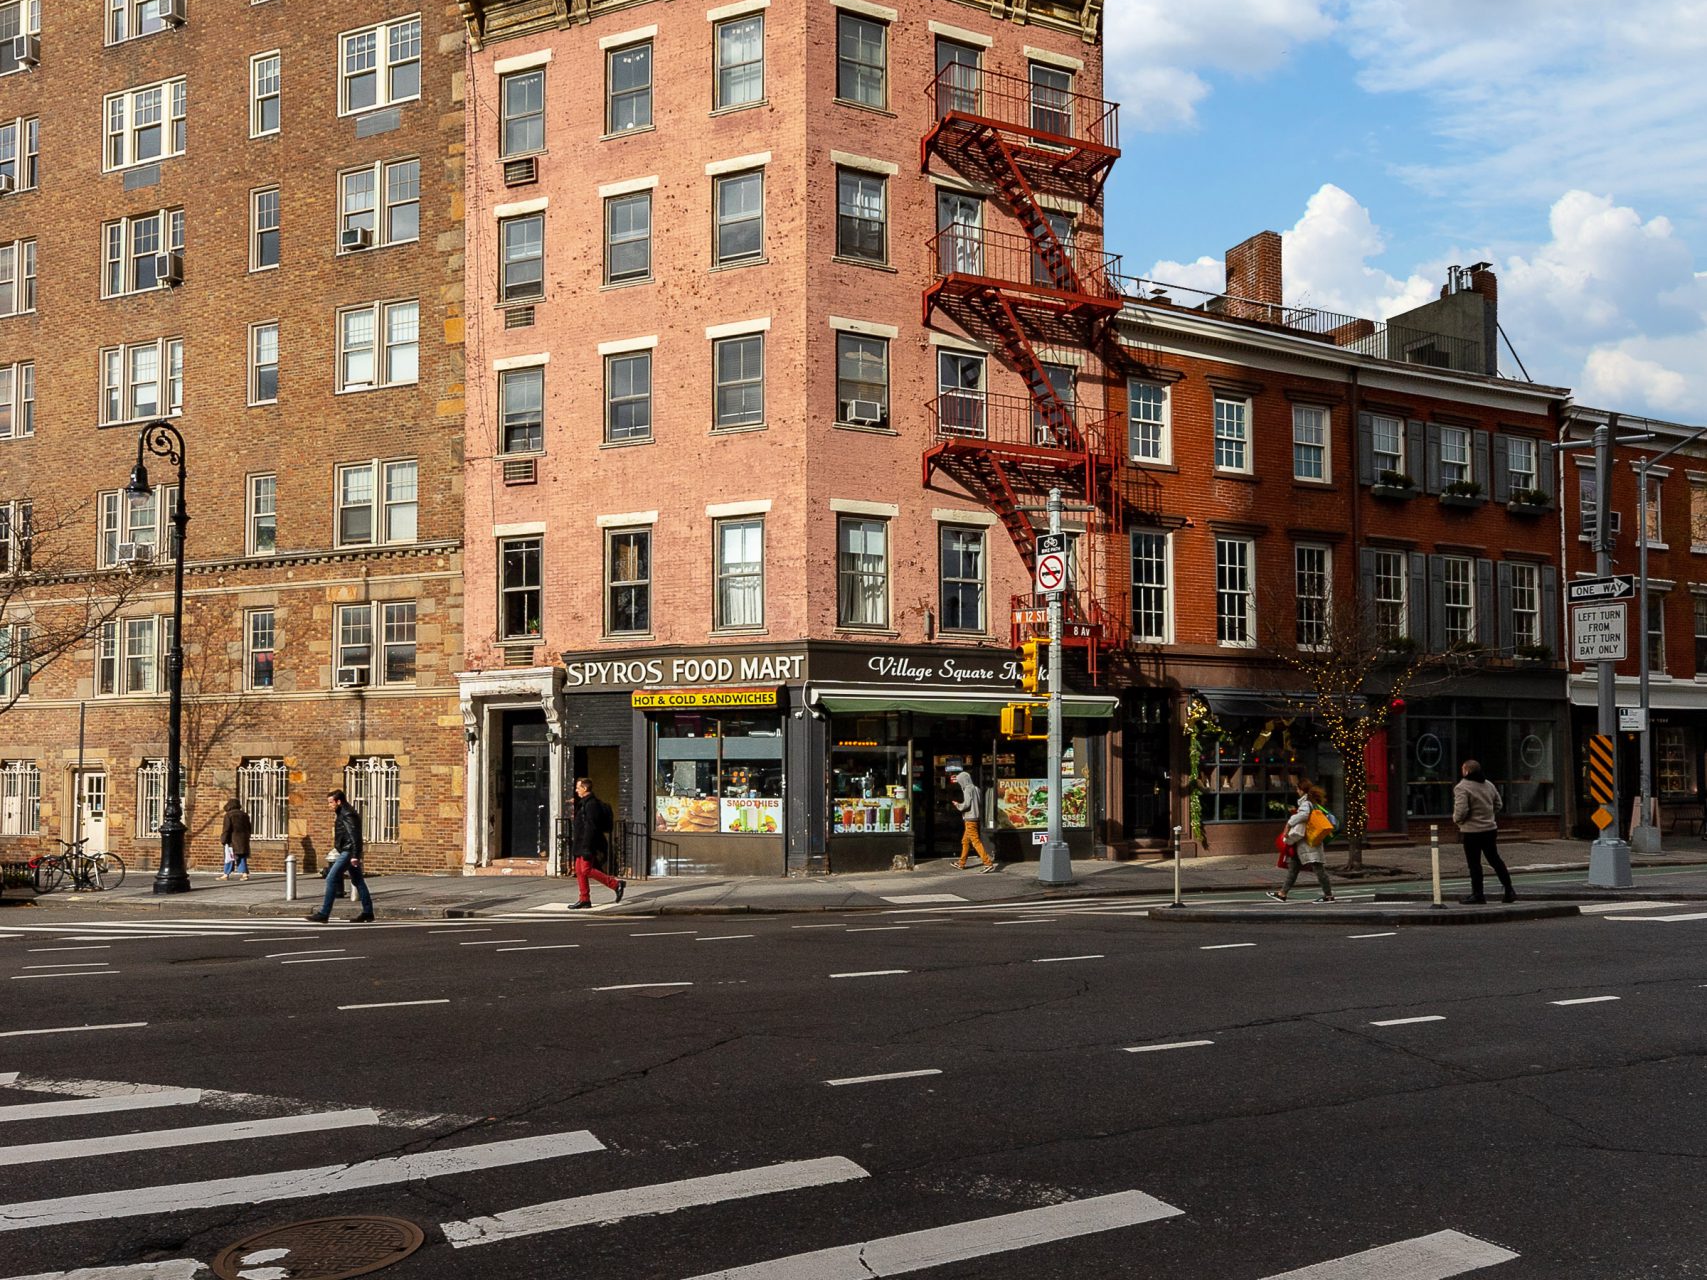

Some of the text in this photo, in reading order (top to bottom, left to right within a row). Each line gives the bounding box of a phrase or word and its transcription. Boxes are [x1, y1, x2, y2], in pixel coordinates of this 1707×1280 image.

[1576, 582, 1623, 596] ONE WAY
[1015, 610, 1047, 622] W 12 ST
[1578, 610, 1621, 622] LEFT TURN
[1073, 626, 1090, 636] 8 Av
[1588, 623, 1610, 632] FROM
[1578, 633, 1621, 644] LEFT TURN
[1580, 645, 1618, 655] BAY ONLY
[567, 655, 804, 686] SPYROS FOOD MART
[868, 656, 933, 681] Village
[938, 658, 994, 682] Square
[633, 693, 775, 706] HOT & COLD SANDWICHES
[726, 800, 779, 808] SMOOTHIES
[837, 822, 908, 833] SMOOTHIES
